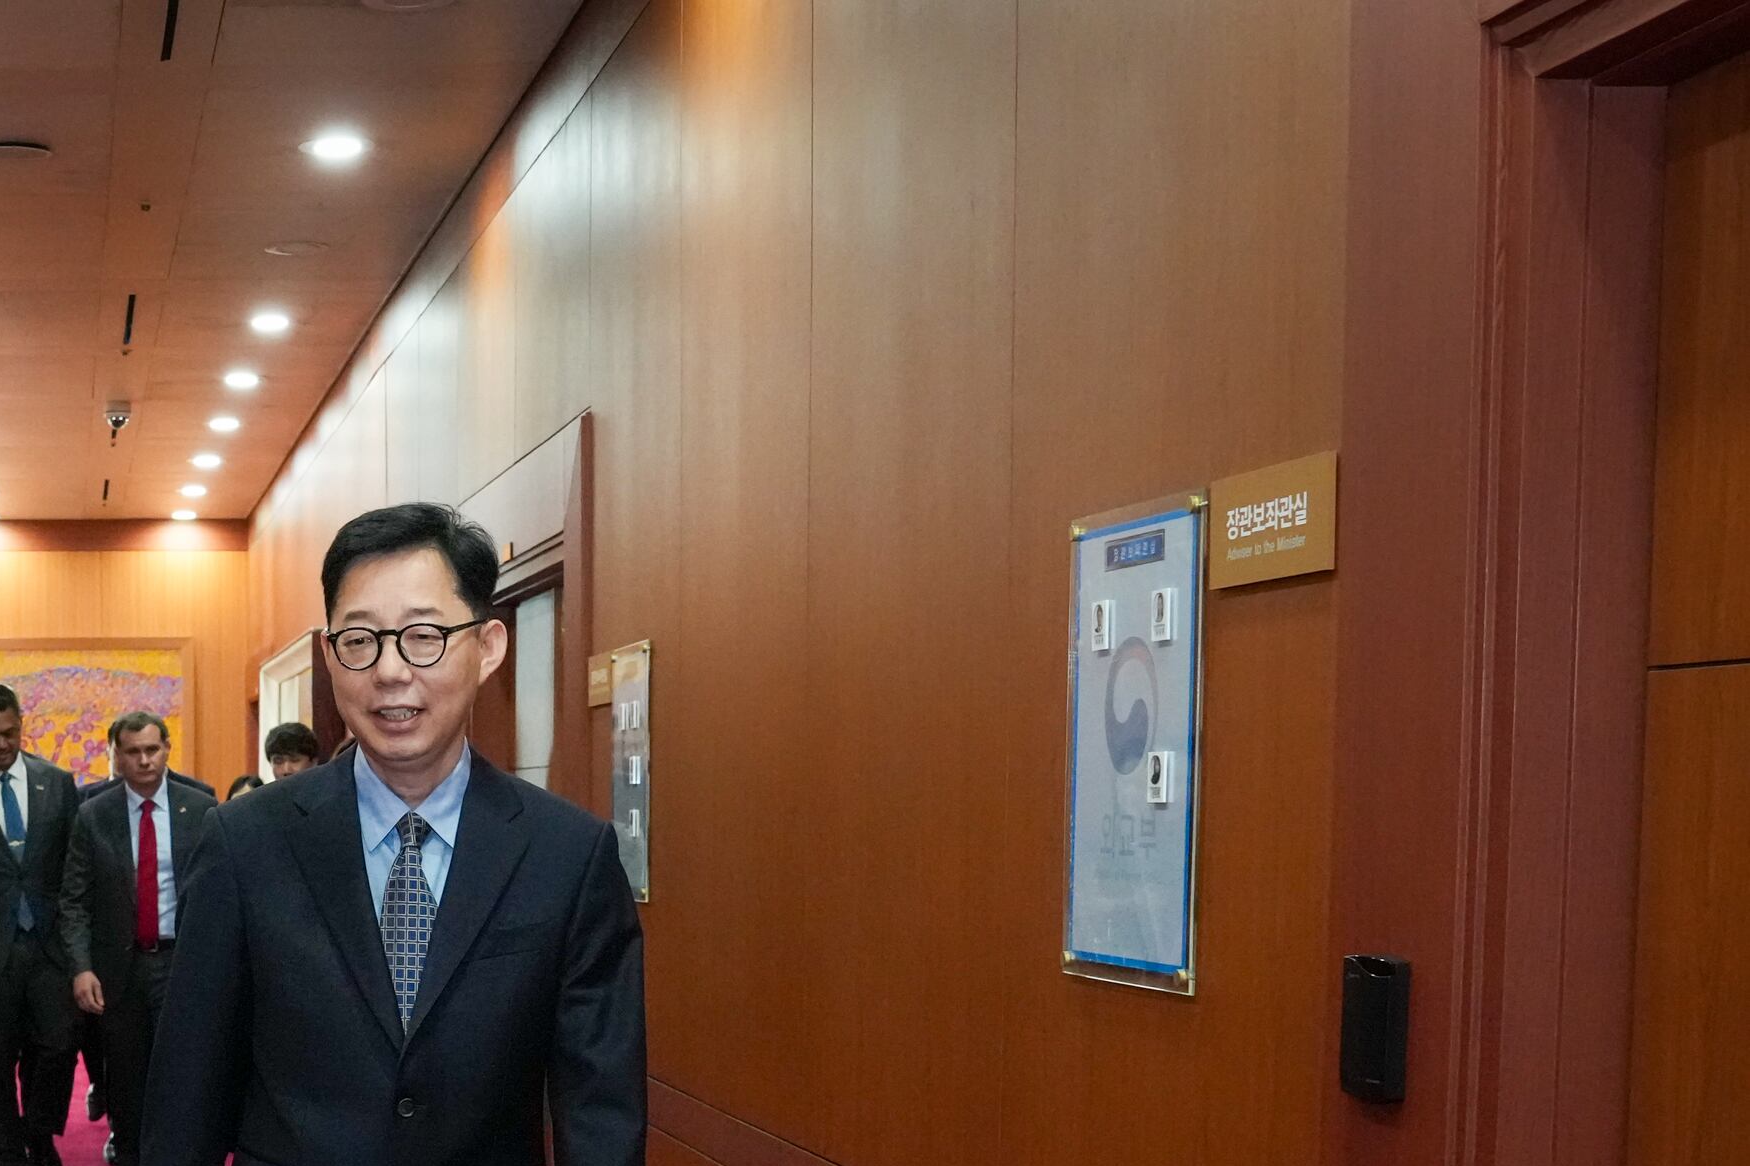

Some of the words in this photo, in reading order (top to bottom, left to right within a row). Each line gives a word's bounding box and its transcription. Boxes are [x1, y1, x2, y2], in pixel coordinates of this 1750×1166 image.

[1226, 491, 1307, 540] 장관보좌관실
[1255, 543, 1262, 555] to
[1264, 540, 1275, 553] the
[1277, 534, 1307, 551] Minister
